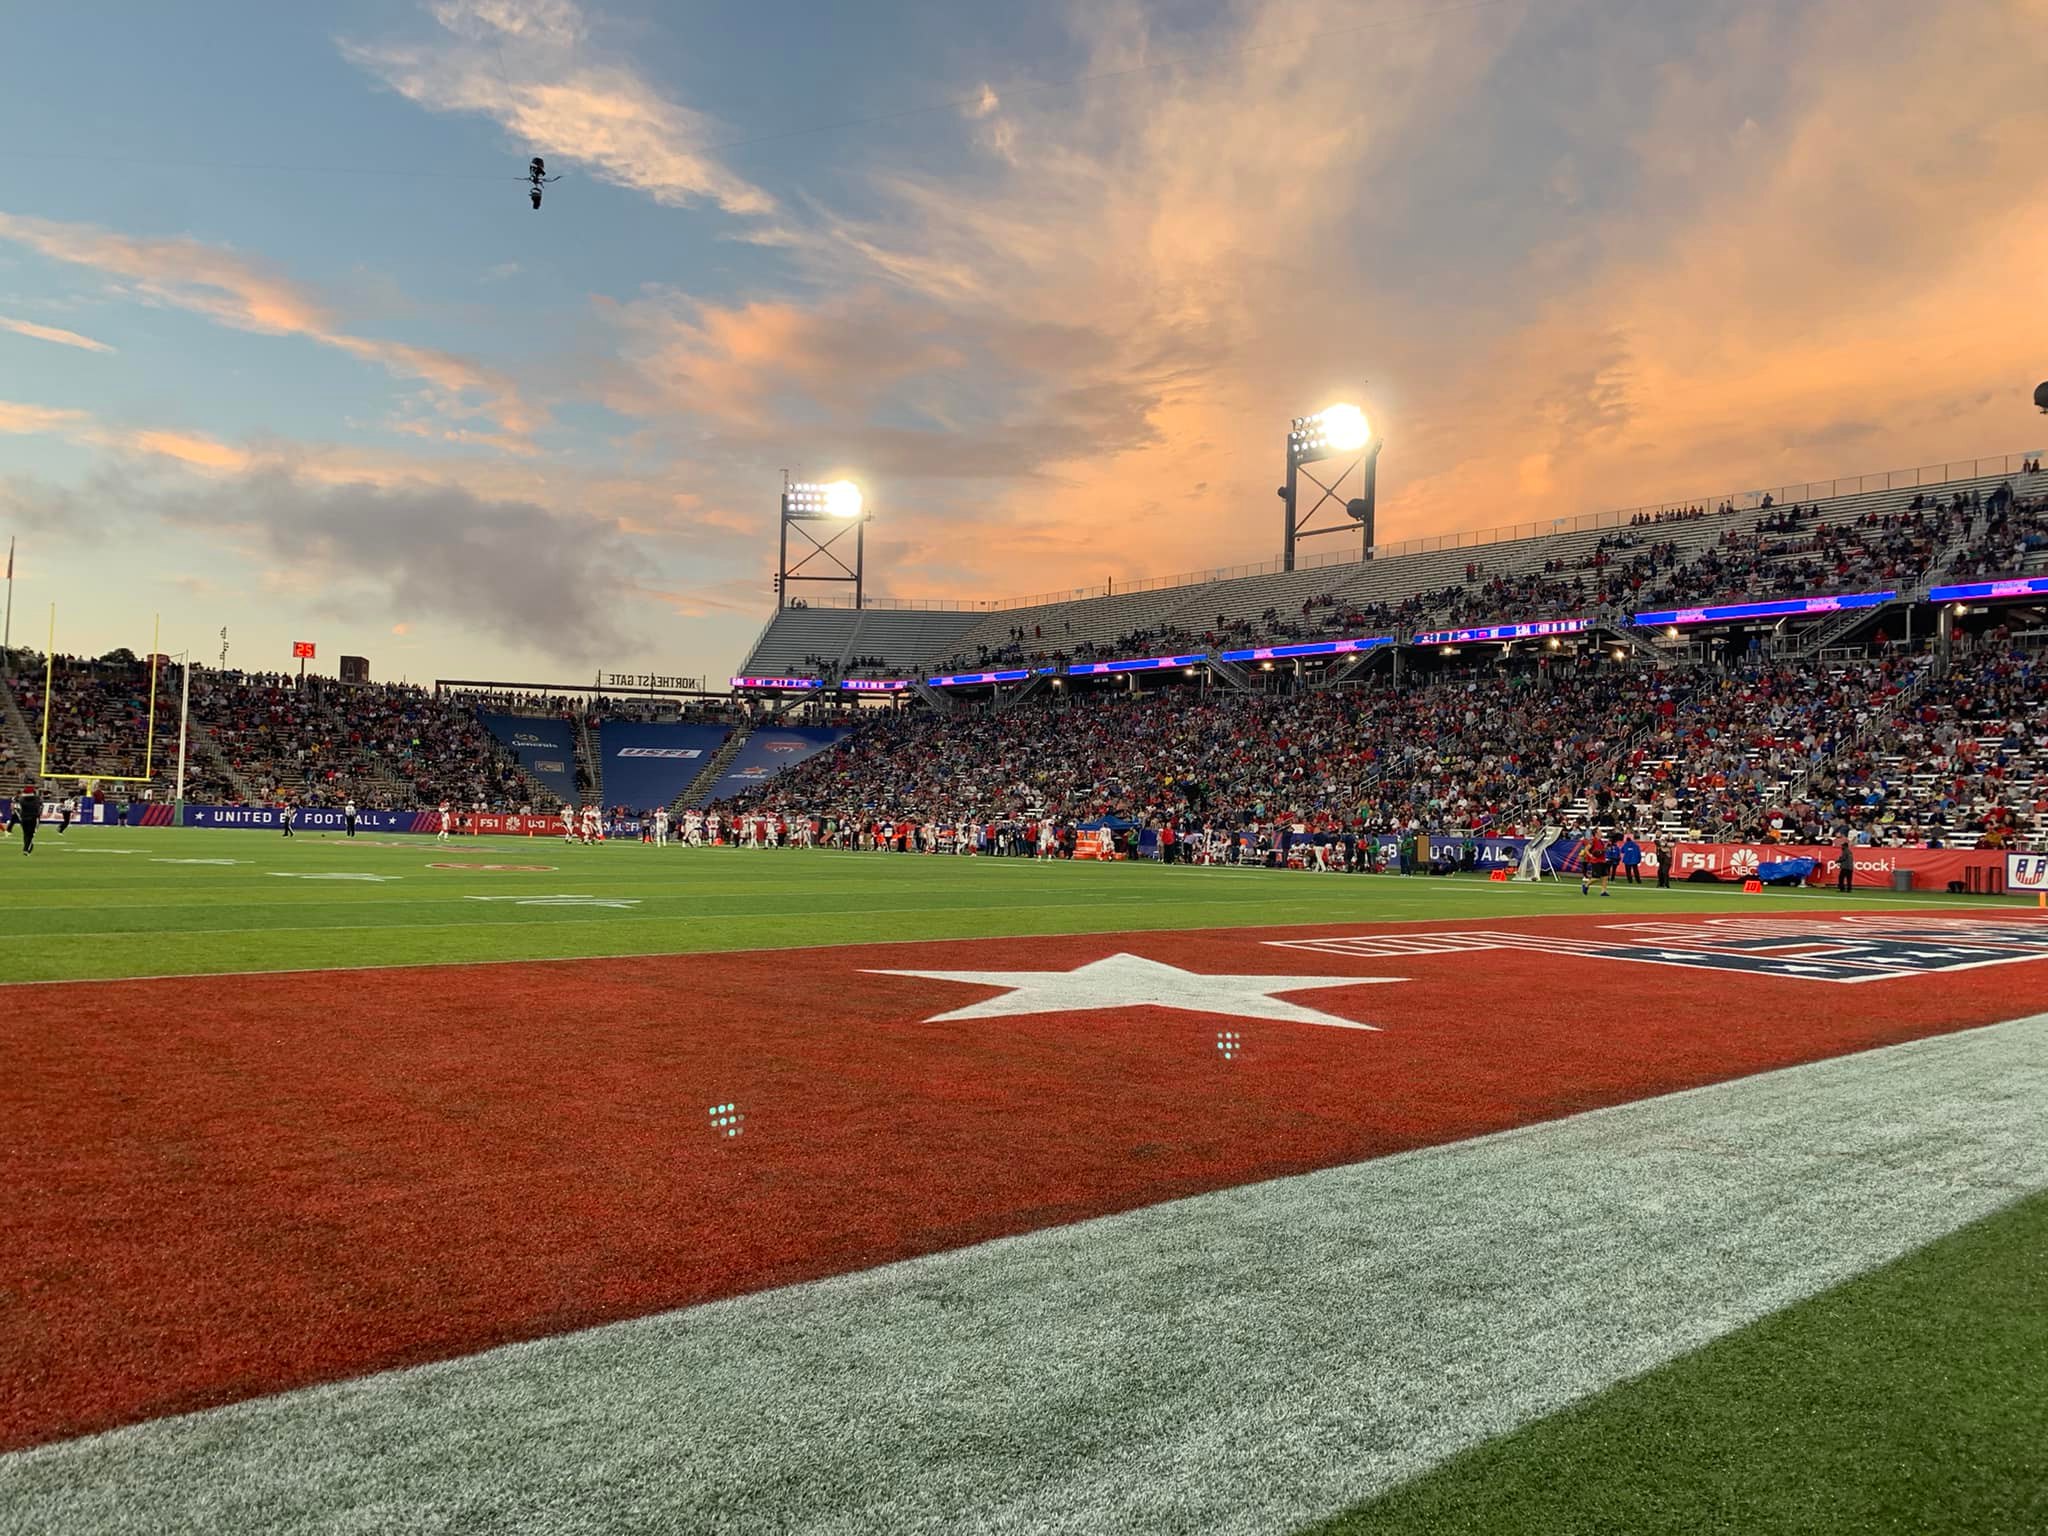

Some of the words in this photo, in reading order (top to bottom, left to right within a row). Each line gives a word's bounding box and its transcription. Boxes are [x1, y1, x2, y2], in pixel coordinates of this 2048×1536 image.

[296, 643, 313, 657] 25
[214, 811, 272, 823] UNITED
[304, 813, 380, 826] FOOTALL
[480, 818, 498, 828] FS1
[1681, 852, 1715, 869] FS1
[1827, 858, 1890, 874] pcock
[1731, 866, 1758, 876] NBC
